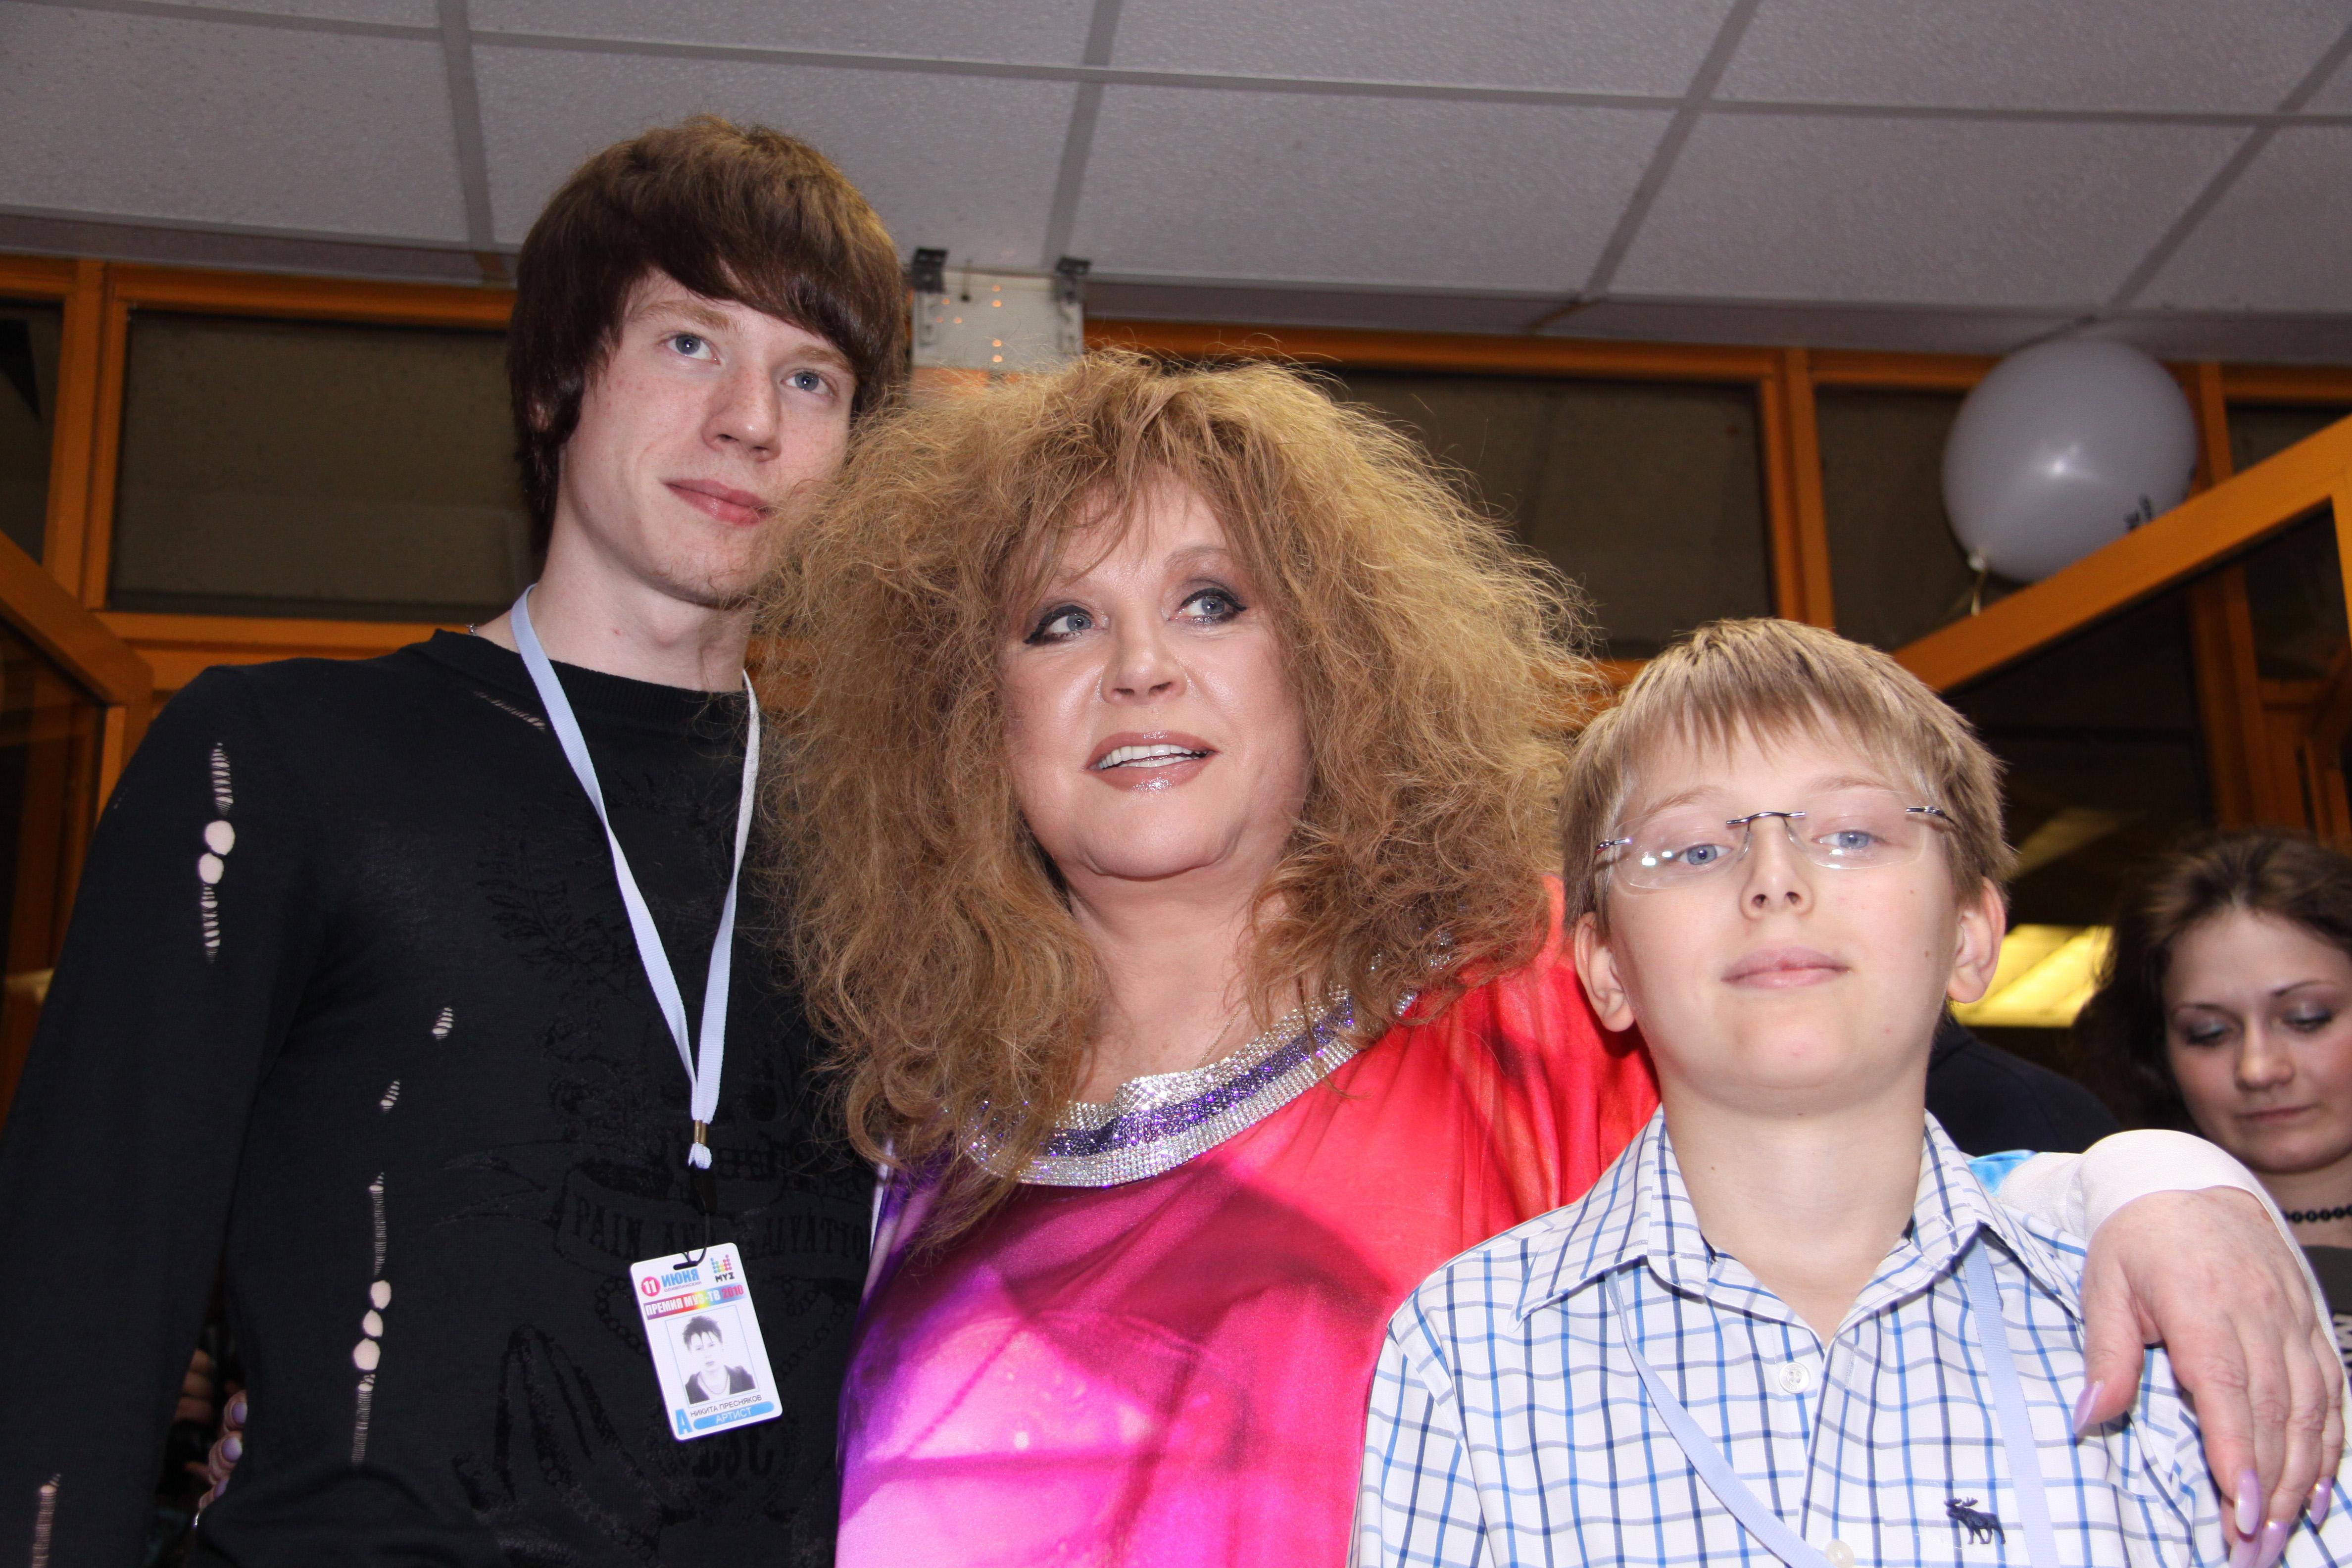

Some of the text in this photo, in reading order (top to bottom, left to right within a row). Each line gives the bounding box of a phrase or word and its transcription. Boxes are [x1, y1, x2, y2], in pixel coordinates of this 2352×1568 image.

[573, 1193, 644, 1261] PAIN
[739, 1206, 865, 1261] ALVATIO
[643, 1268, 700, 1294] 11 ИЮНЯ
[645, 1285, 744, 1316] ПРЕМИЯ МУЗ-ТВ 2010
[689, 1394, 762, 1418] НИКИТА ПРЕСНЯКОВ
[716, 1407, 753, 1423] АРТИСТ
